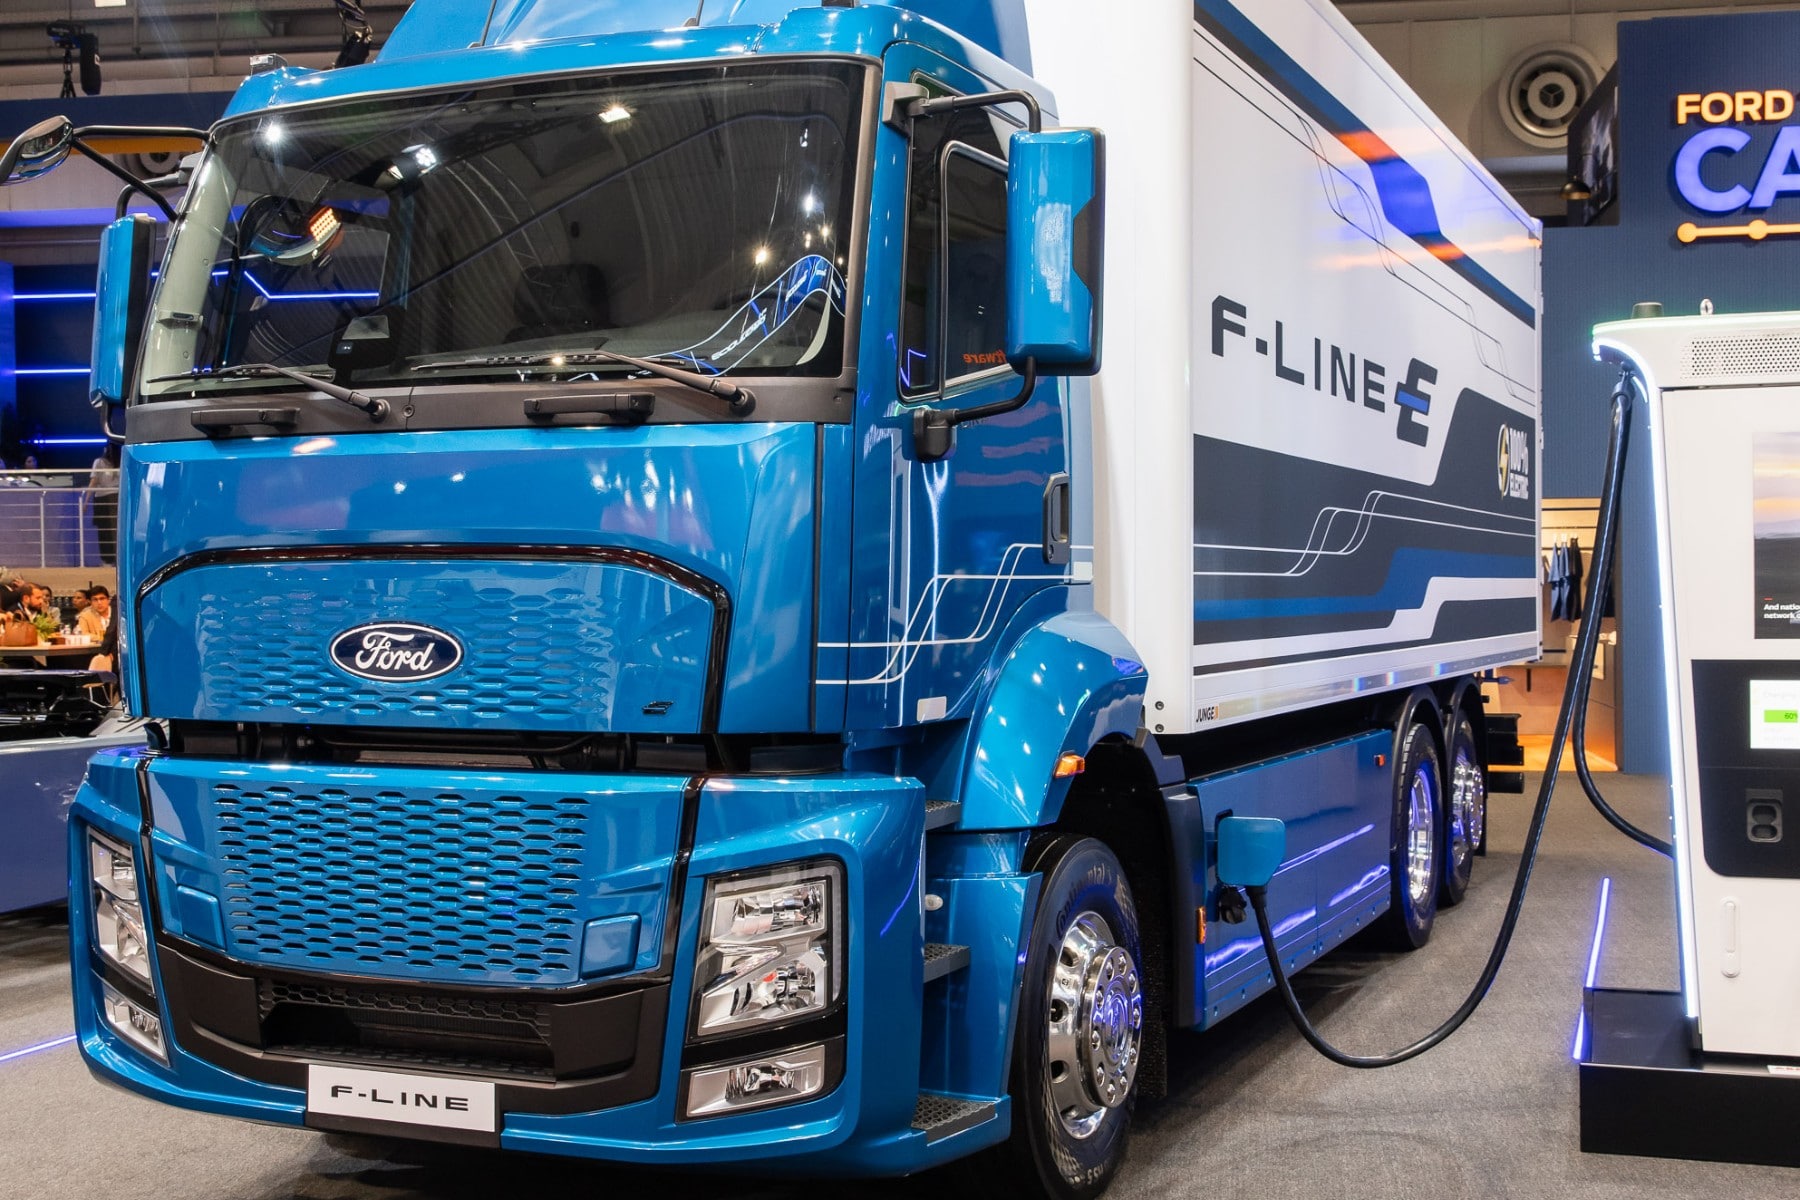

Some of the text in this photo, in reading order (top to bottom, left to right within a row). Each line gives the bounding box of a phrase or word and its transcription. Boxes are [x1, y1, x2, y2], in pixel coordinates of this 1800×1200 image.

[1677, 89, 1795, 125] FORD
[1675, 125, 1800, 213] CA
[1211, 294, 1386, 414] F-LINE
[1763, 603, 1780, 611] And
[355, 631, 436, 671] Ford
[1195, 706, 1215, 723] JUNGE
[330, 1084, 469, 1112] F-LINE
